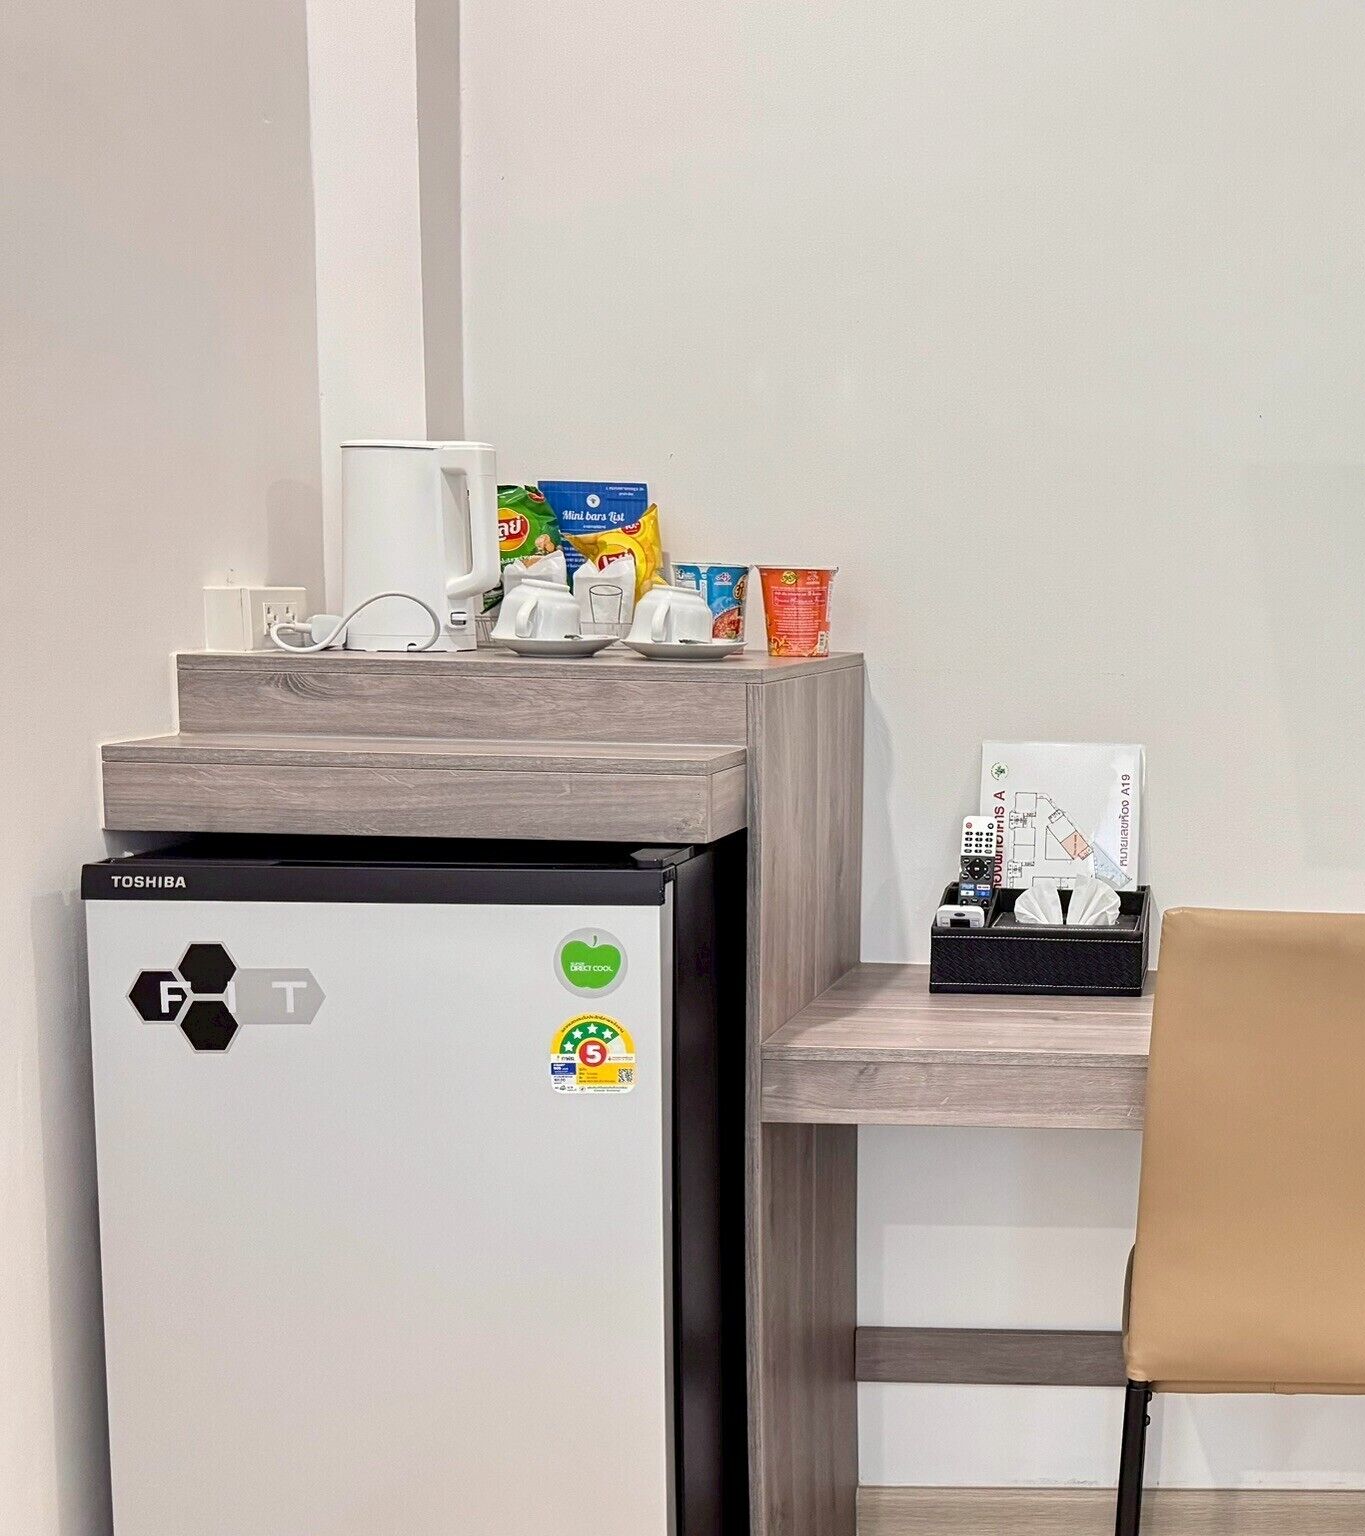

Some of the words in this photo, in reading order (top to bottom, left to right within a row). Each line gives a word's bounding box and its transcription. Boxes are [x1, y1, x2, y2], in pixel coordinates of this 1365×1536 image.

[562, 509, 584, 521] Mini
[585, 511, 607, 521] bars
[608, 511, 625, 524] List
[498, 517, 522, 536] ลย์
[1120, 774, 1131, 796] A19
[993, 790, 1005, 801] A
[1118, 800, 1129, 867] หมายเลขห้อง
[111, 876, 187, 888] TOSHIBA
[585, 1044, 602, 1064] 5
